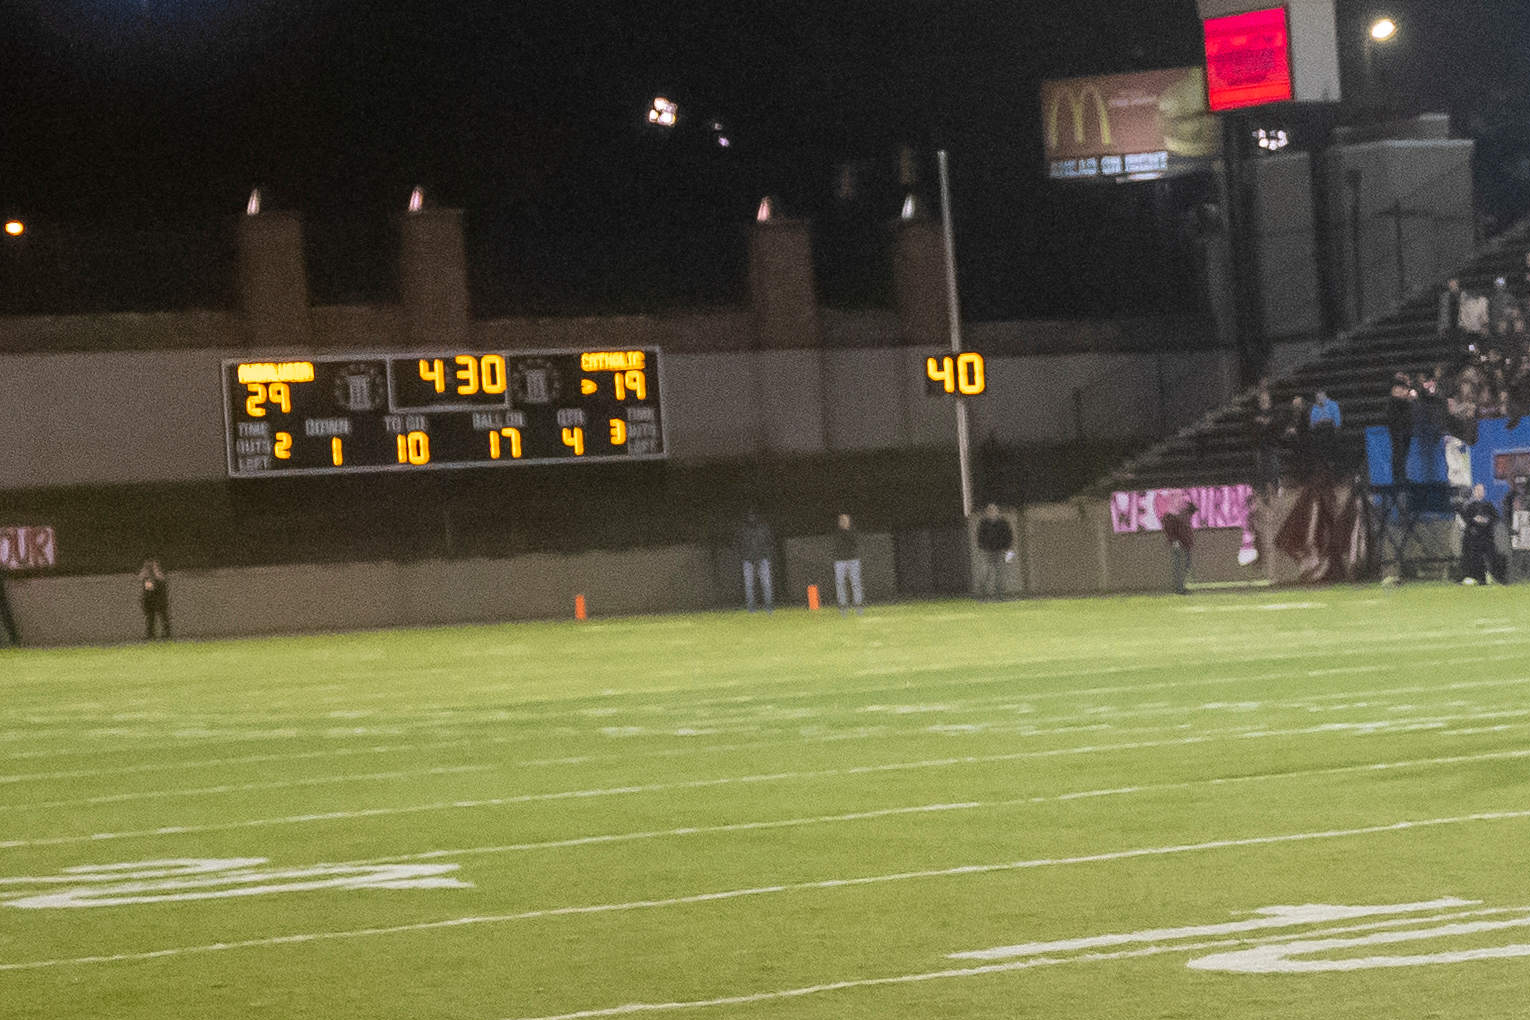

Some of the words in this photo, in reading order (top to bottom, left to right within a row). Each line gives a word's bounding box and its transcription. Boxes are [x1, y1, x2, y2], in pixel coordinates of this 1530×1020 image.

[614, 370, 646, 401] 19
[926, 352, 985, 395] 40
[246, 383, 292, 418] 29
[274, 431, 293, 460] 2
[489, 427, 522, 459] 17
[562, 426, 585, 456] 4
[609, 418, 627, 445] 3
[331, 436, 343, 466] 1
[396, 431, 430, 465] 10
